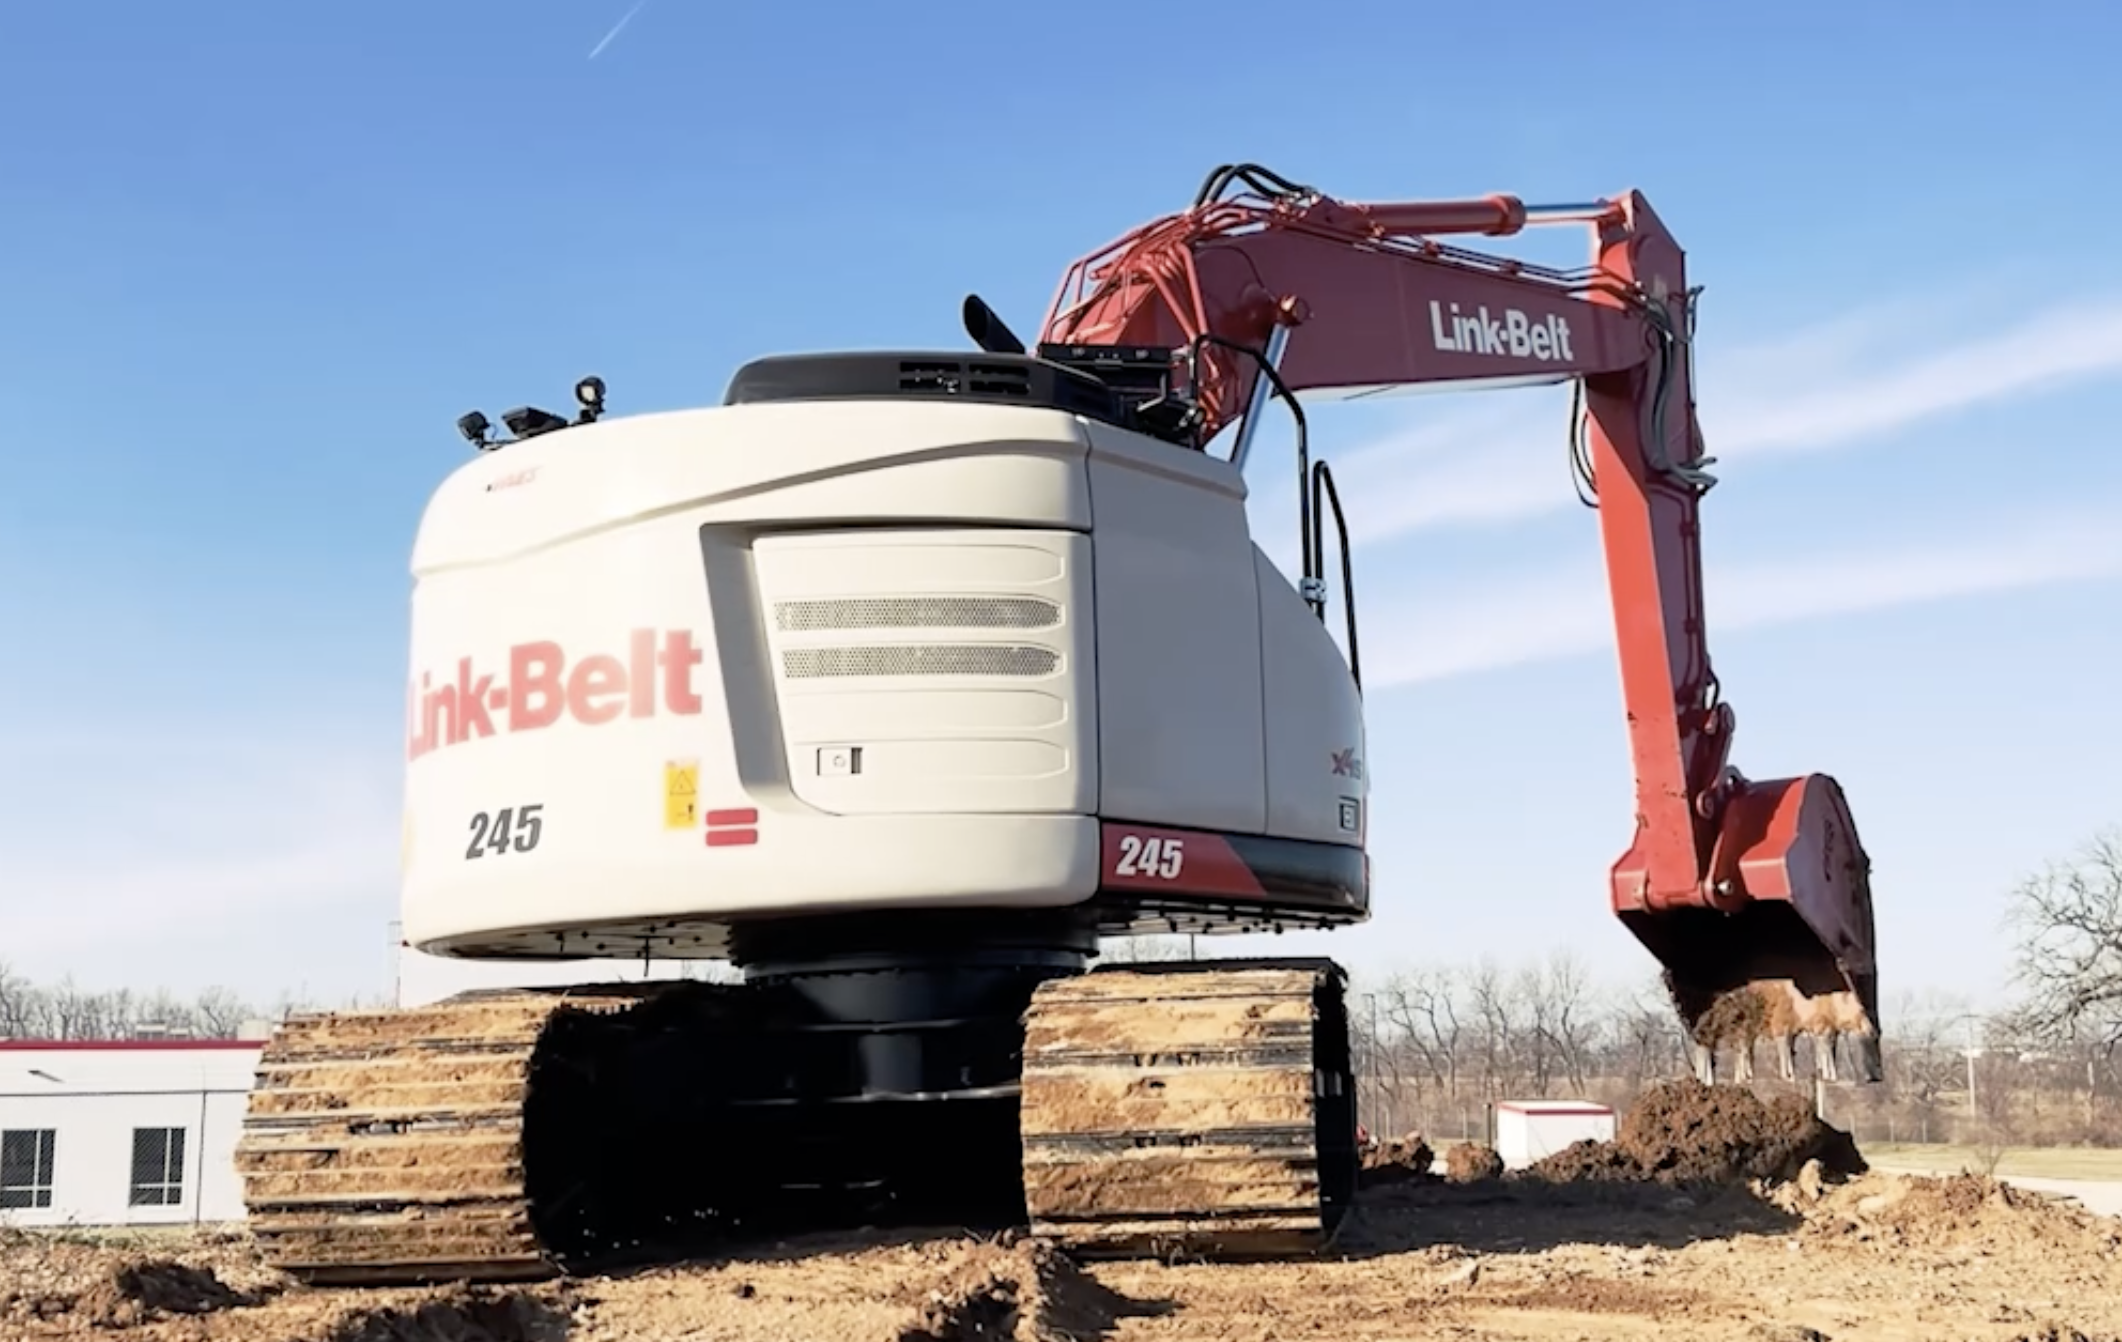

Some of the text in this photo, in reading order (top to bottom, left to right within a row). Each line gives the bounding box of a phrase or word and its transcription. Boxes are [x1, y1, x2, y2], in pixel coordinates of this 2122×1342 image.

[1430, 300, 1574, 361] Link-Belt
[408, 627, 703, 762] Link-Belt
[465, 803, 543, 859] 245
[1115, 835, 1184, 879] 245
